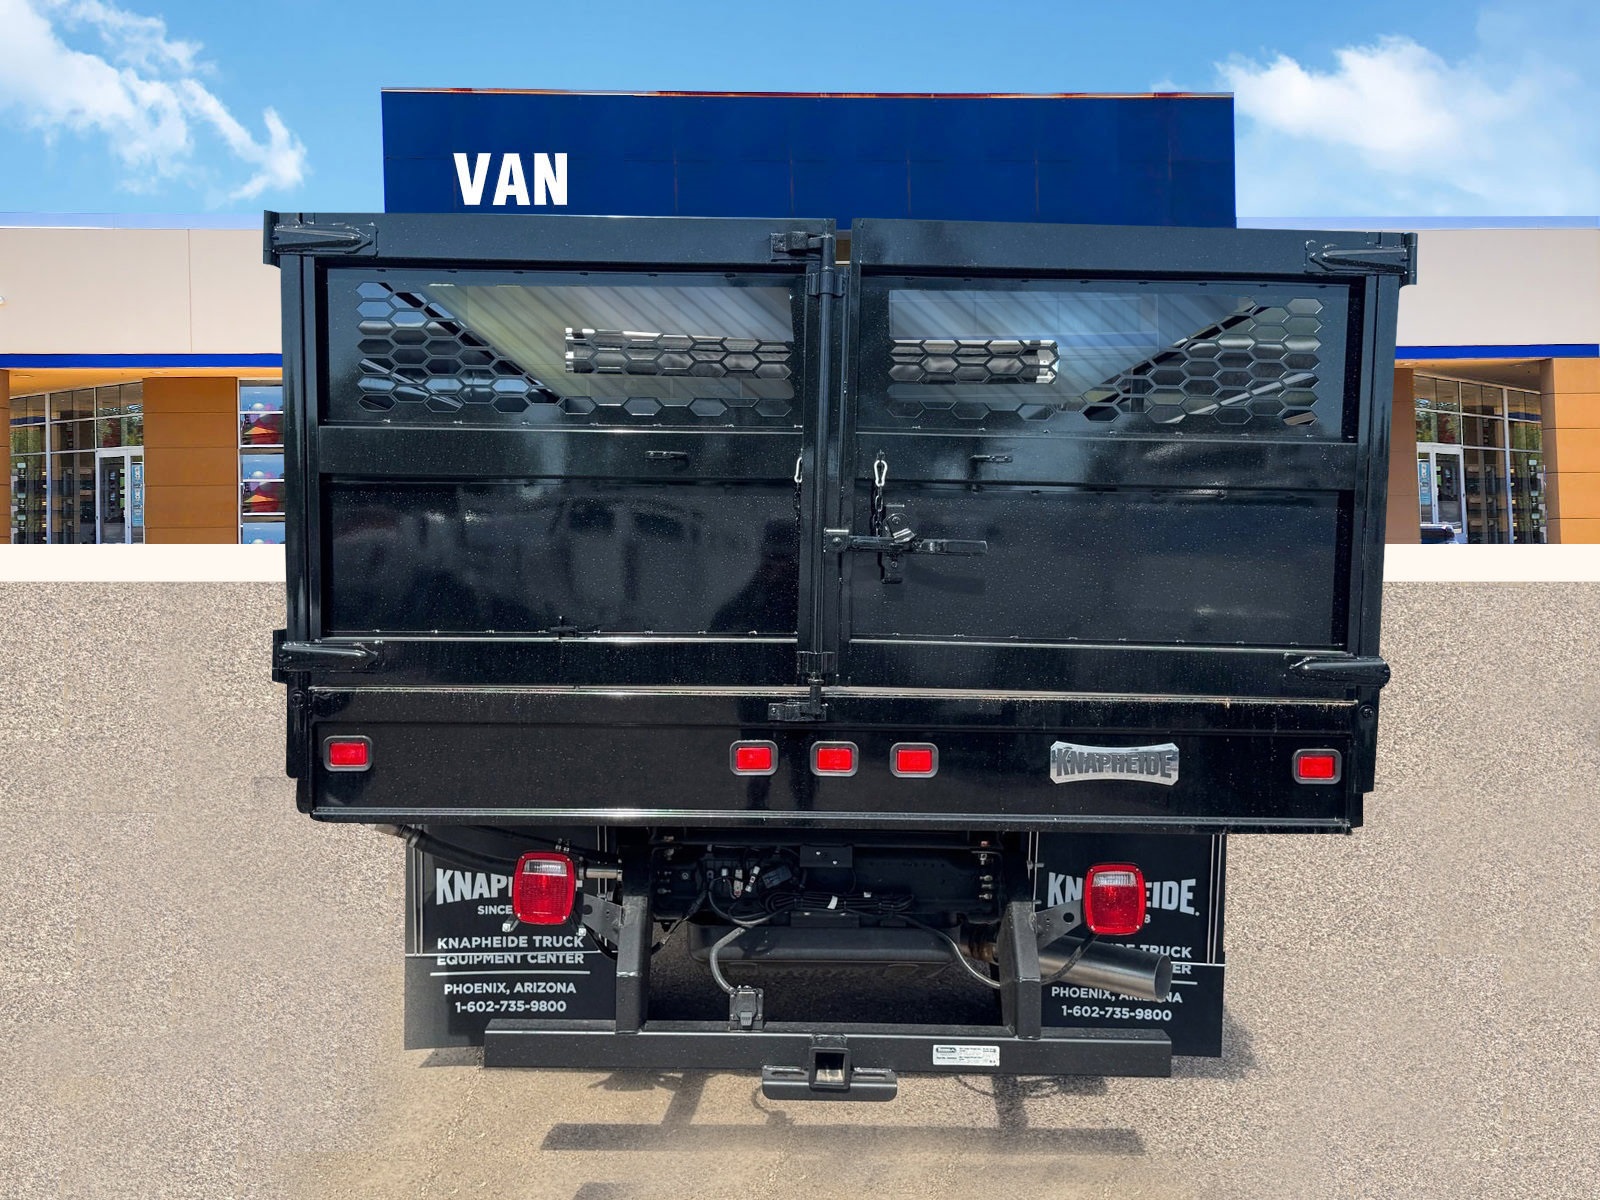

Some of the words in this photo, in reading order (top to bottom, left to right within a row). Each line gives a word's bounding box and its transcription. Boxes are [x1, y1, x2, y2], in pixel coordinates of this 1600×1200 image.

[453, 152, 568, 206] VAN
[1056, 747, 1172, 779] KNAPHEIDE
[477, 905, 513, 915] SINCE
[437, 936, 529, 949] KNAPHEIDE
[532, 935, 584, 948] TRUCK
[437, 953, 522, 966] EQUIPMENT
[527, 952, 584, 964] CENTER
[443, 982, 511, 996] PHOENIX,
[513, 982, 577, 994] ARIZONA
[1051, 986, 1116, 1001] PHOENIX,
[455, 1001, 567, 1013] 1-602-735-9800
[1061, 1005, 1172, 1021] 1-602-735-9800
